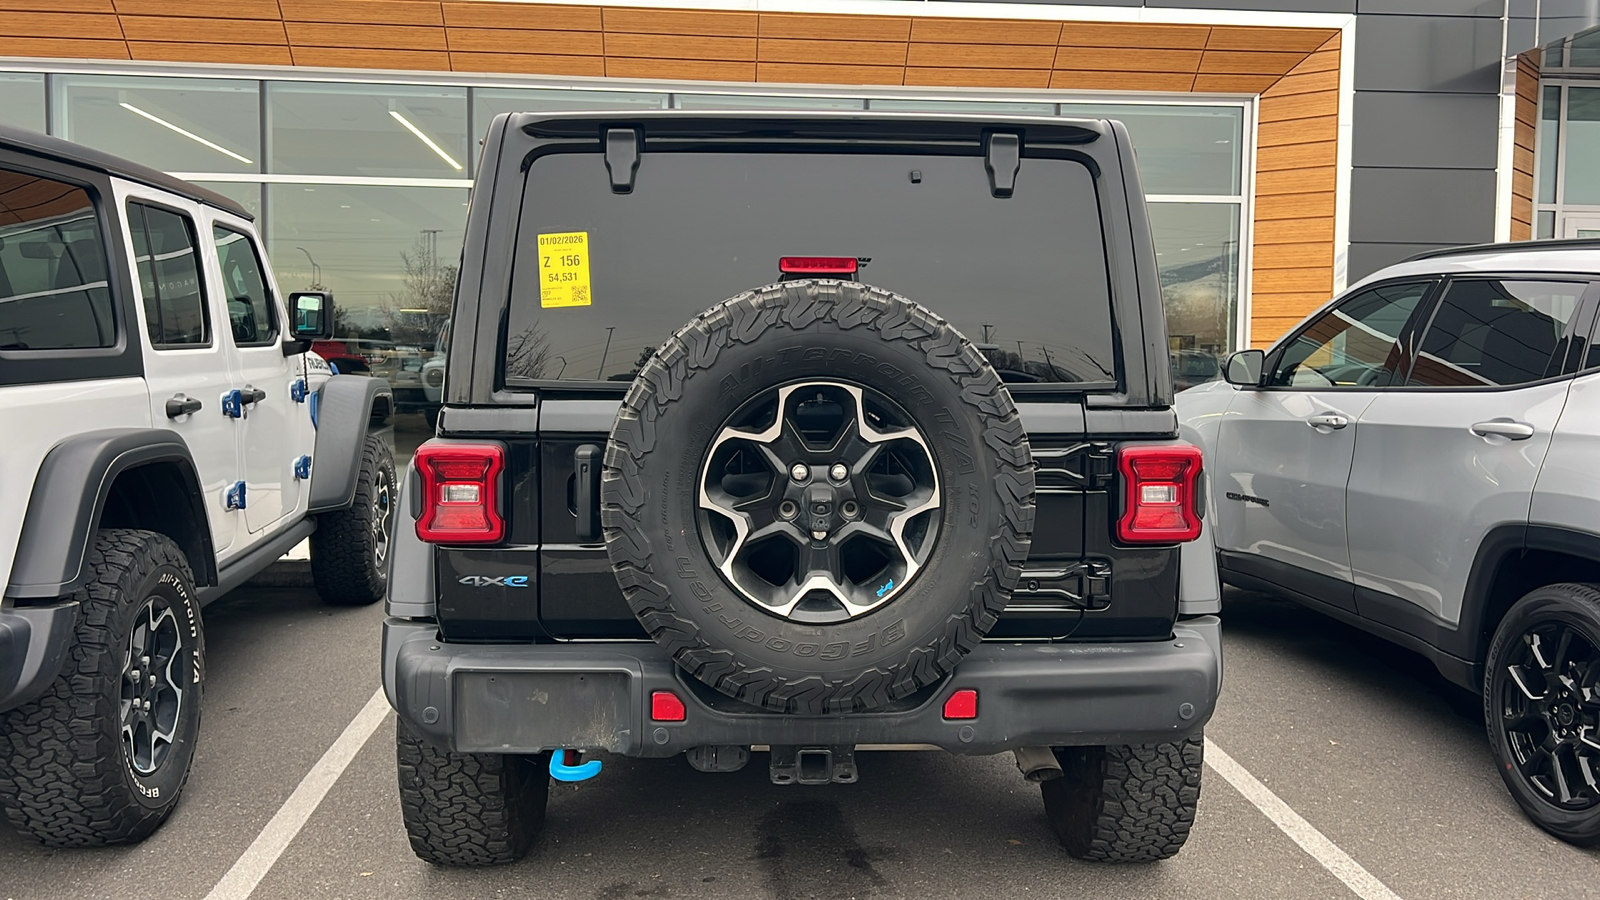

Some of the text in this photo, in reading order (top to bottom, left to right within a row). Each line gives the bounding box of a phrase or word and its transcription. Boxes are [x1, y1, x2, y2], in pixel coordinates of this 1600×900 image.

[540, 235, 583, 245] 01/02/2026
[543, 254, 580, 268] Z 156
[548, 272, 577, 283] 54,531
[718, 346, 935, 405] All-Terrain
[934, 405, 976, 475] T/A
[675, 555, 907, 661] BFGoodrich
